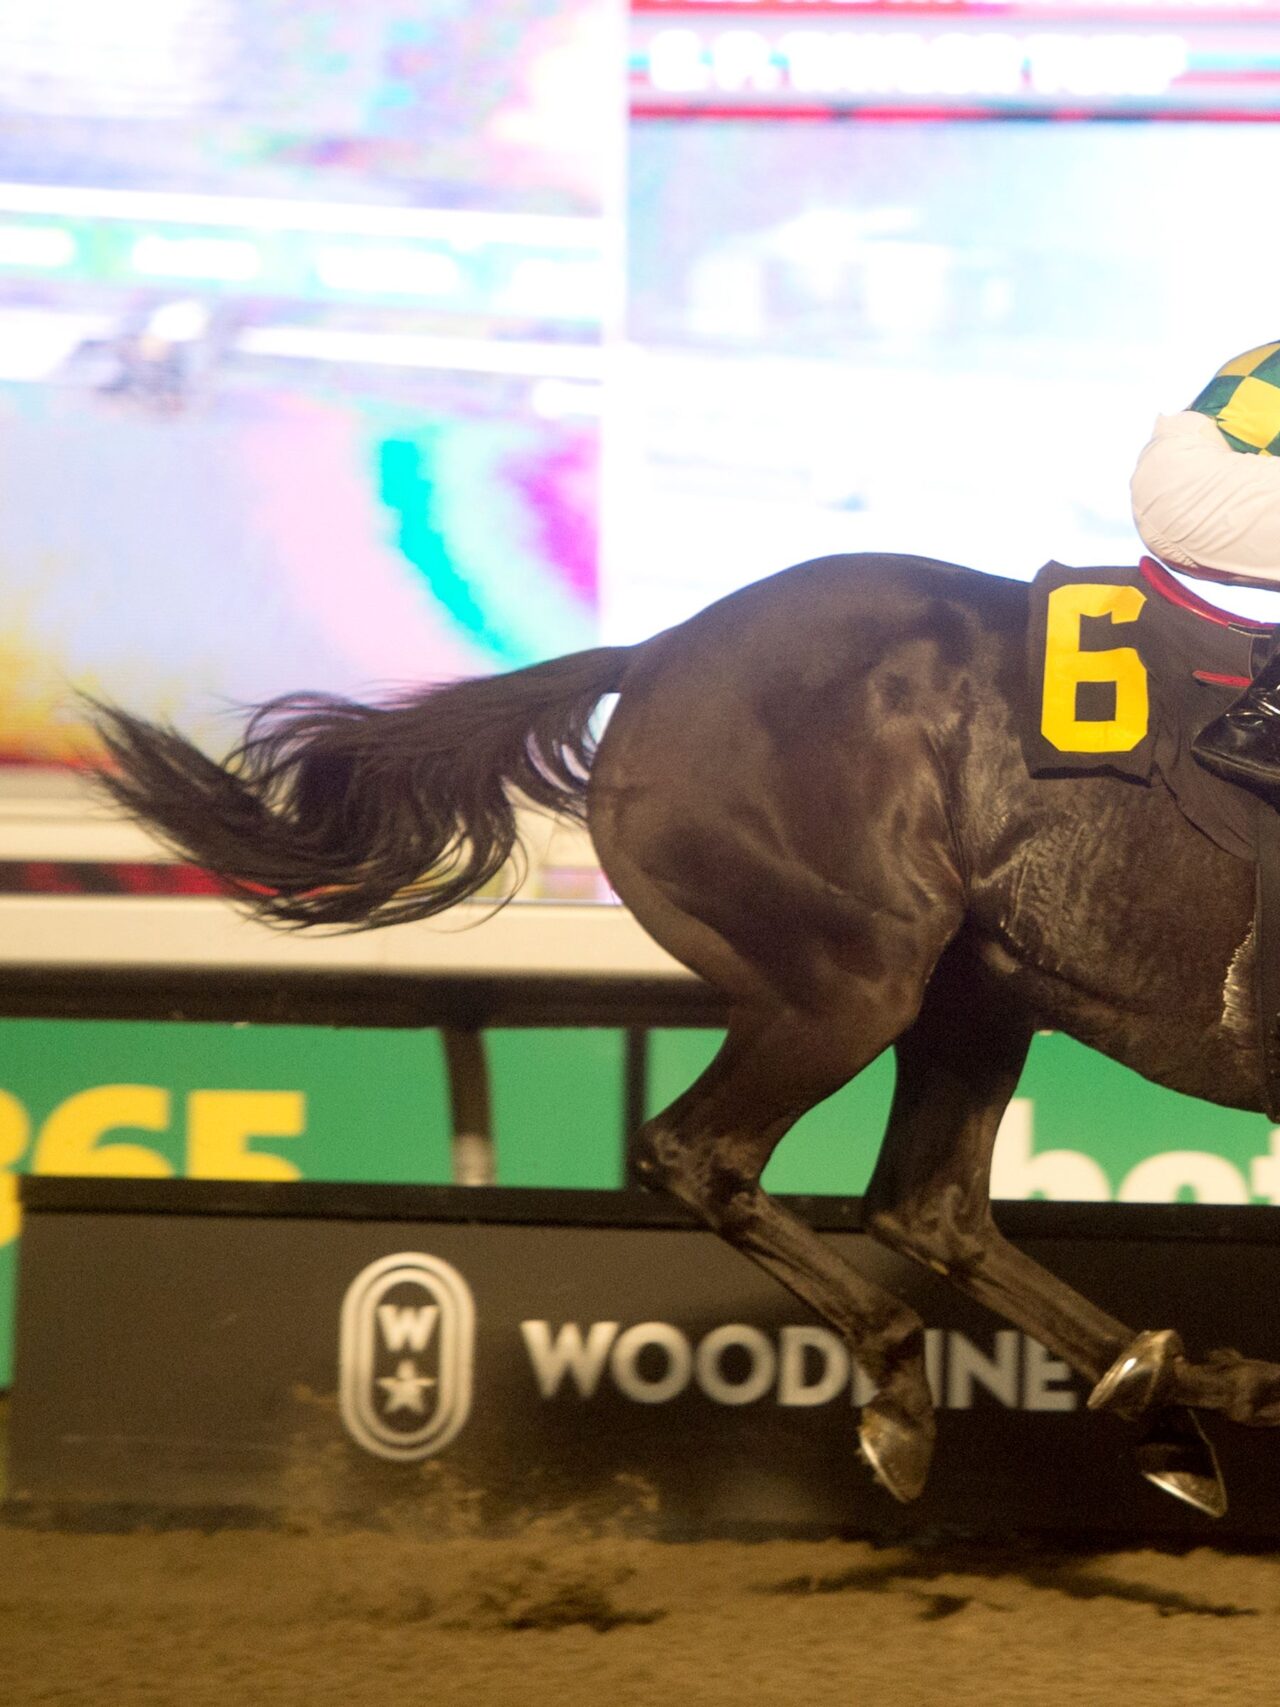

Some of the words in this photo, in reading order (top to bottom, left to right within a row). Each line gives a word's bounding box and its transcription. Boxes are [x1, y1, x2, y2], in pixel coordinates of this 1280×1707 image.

[1041, 583, 1149, 753] 6
[377, 1304, 439, 1352] W
[521, 1319, 1078, 1411] WOODINE
